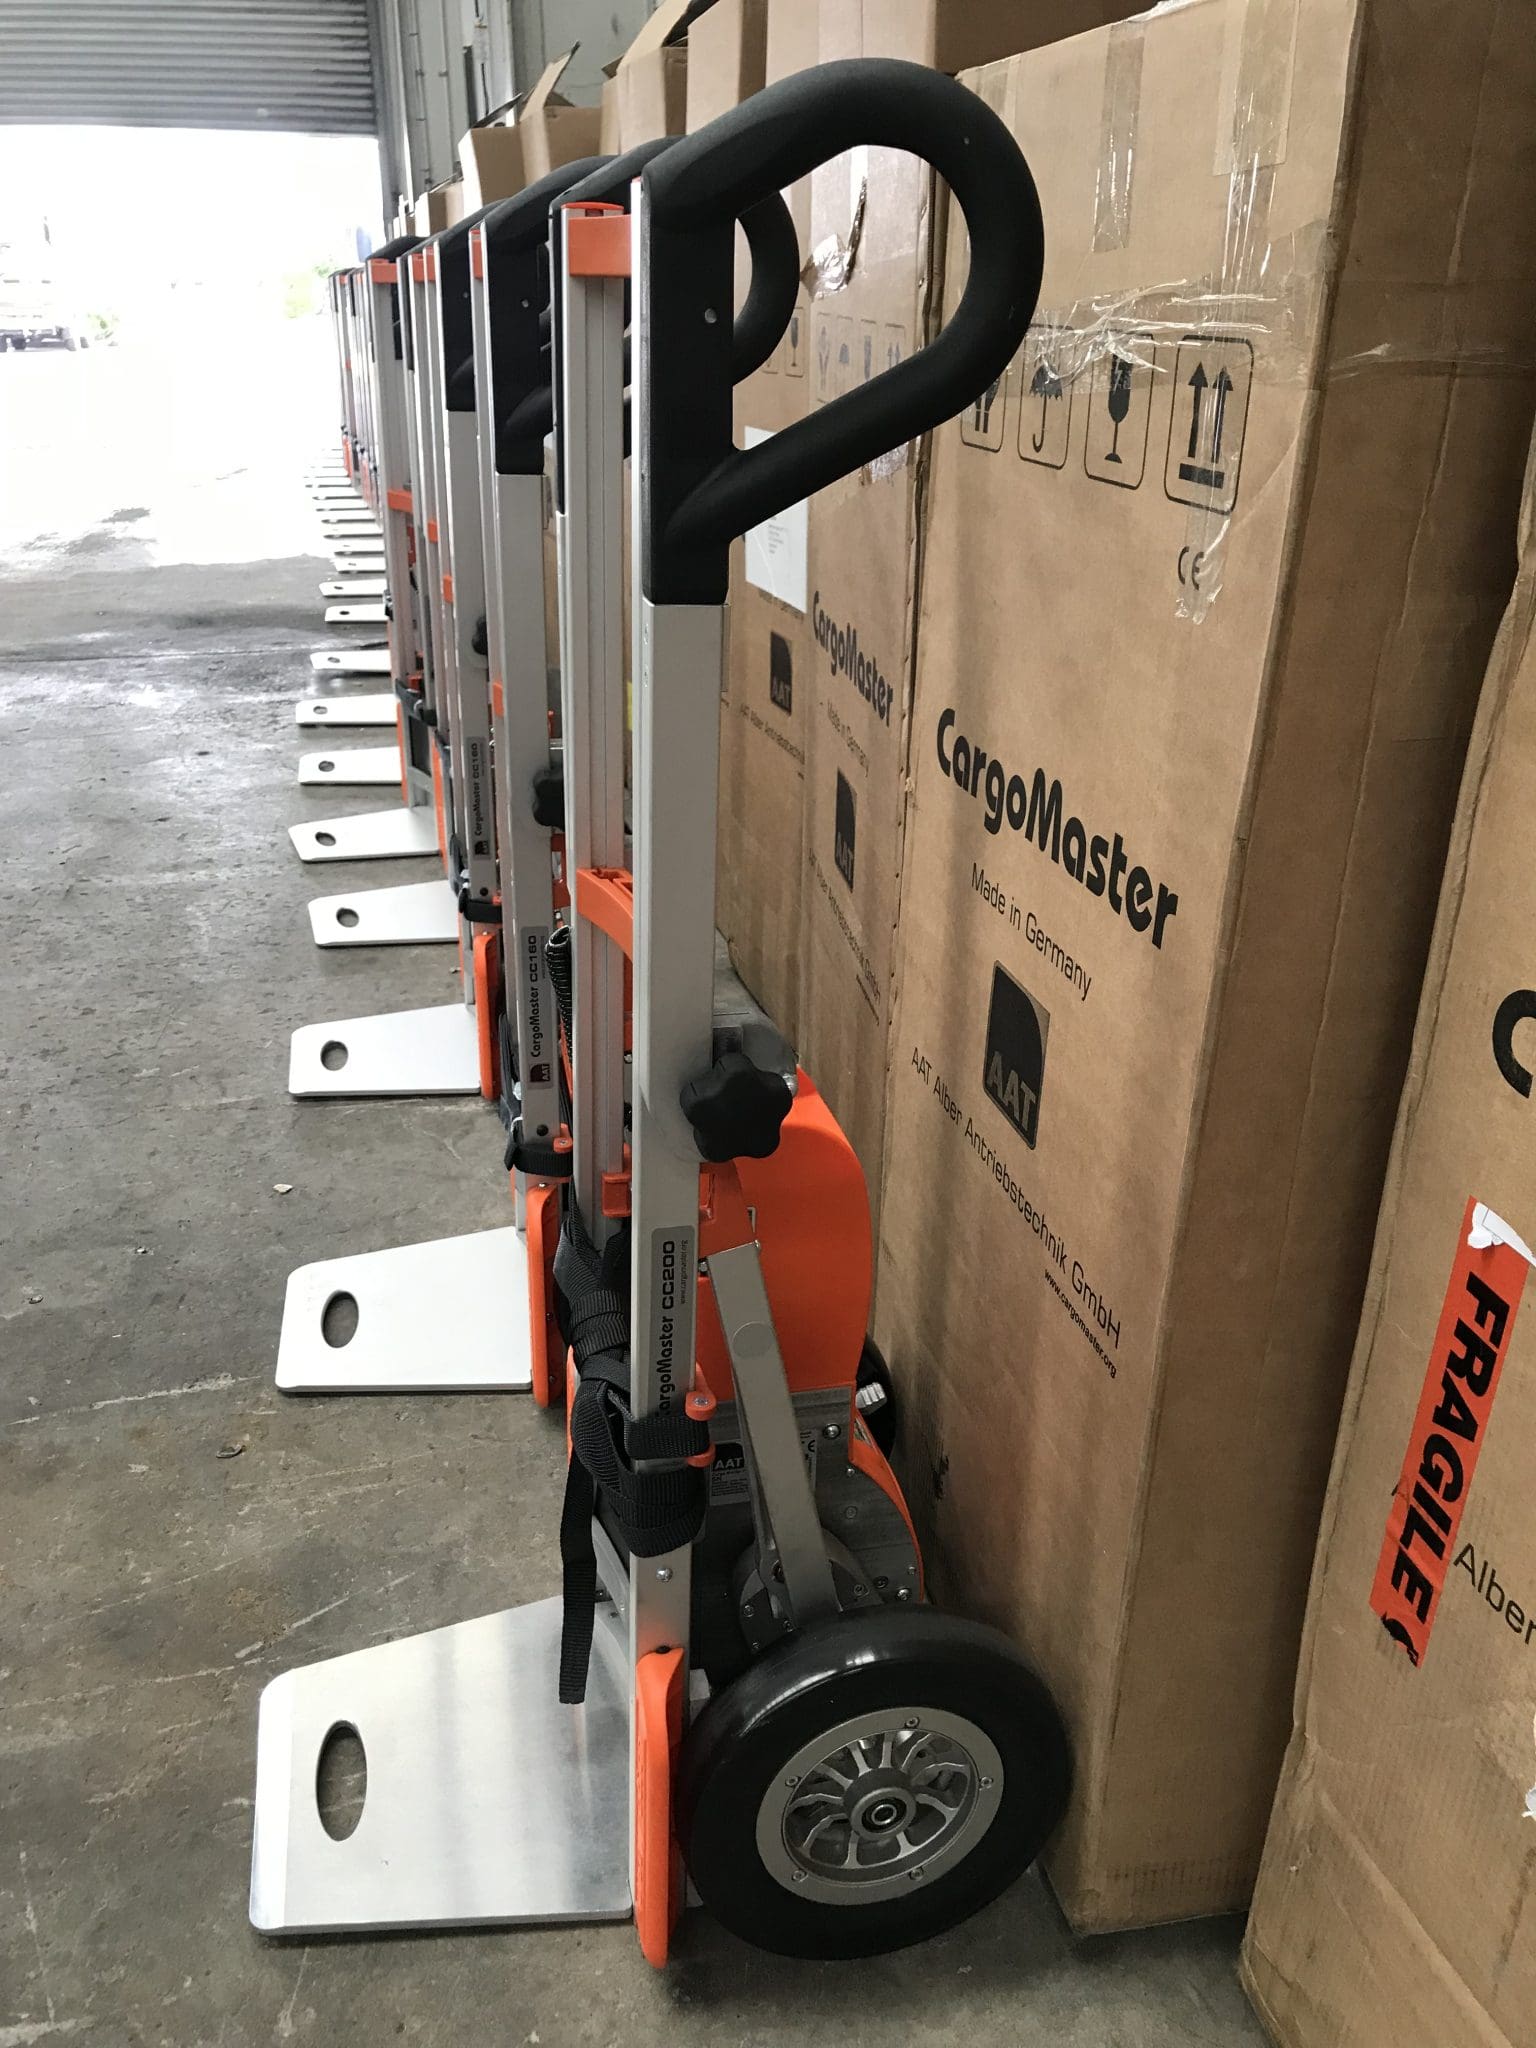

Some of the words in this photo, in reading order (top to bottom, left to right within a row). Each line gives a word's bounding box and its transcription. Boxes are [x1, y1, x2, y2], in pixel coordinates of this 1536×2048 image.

[812, 590, 894, 728] CargoMaster
[936, 707, 1179, 950] CargoMaster
[971, 862, 1006, 915] Made
[1009, 896, 1021, 931] in
[1025, 912, 1092, 1001] Germany
[529, 986, 543, 1058] CargoMaster
[986, 1049, 1037, 1132] AAT
[911, 1046, 933, 1086] AAT
[933, 1075, 963, 1126] Alber
[964, 1117, 1069, 1275] Antriebstechnik
[1071, 1260, 1121, 1350] GmbH
[662, 1240, 675, 1310] CC200
[1044, 1268, 1117, 1379] www.cargomaster.org
[656, 1315, 675, 1416] argoMaster
[714, 1457, 743, 1471] AAT
[1391, 1270, 1511, 1625] FRAGILE
[1453, 1542, 1536, 1645] Alber
